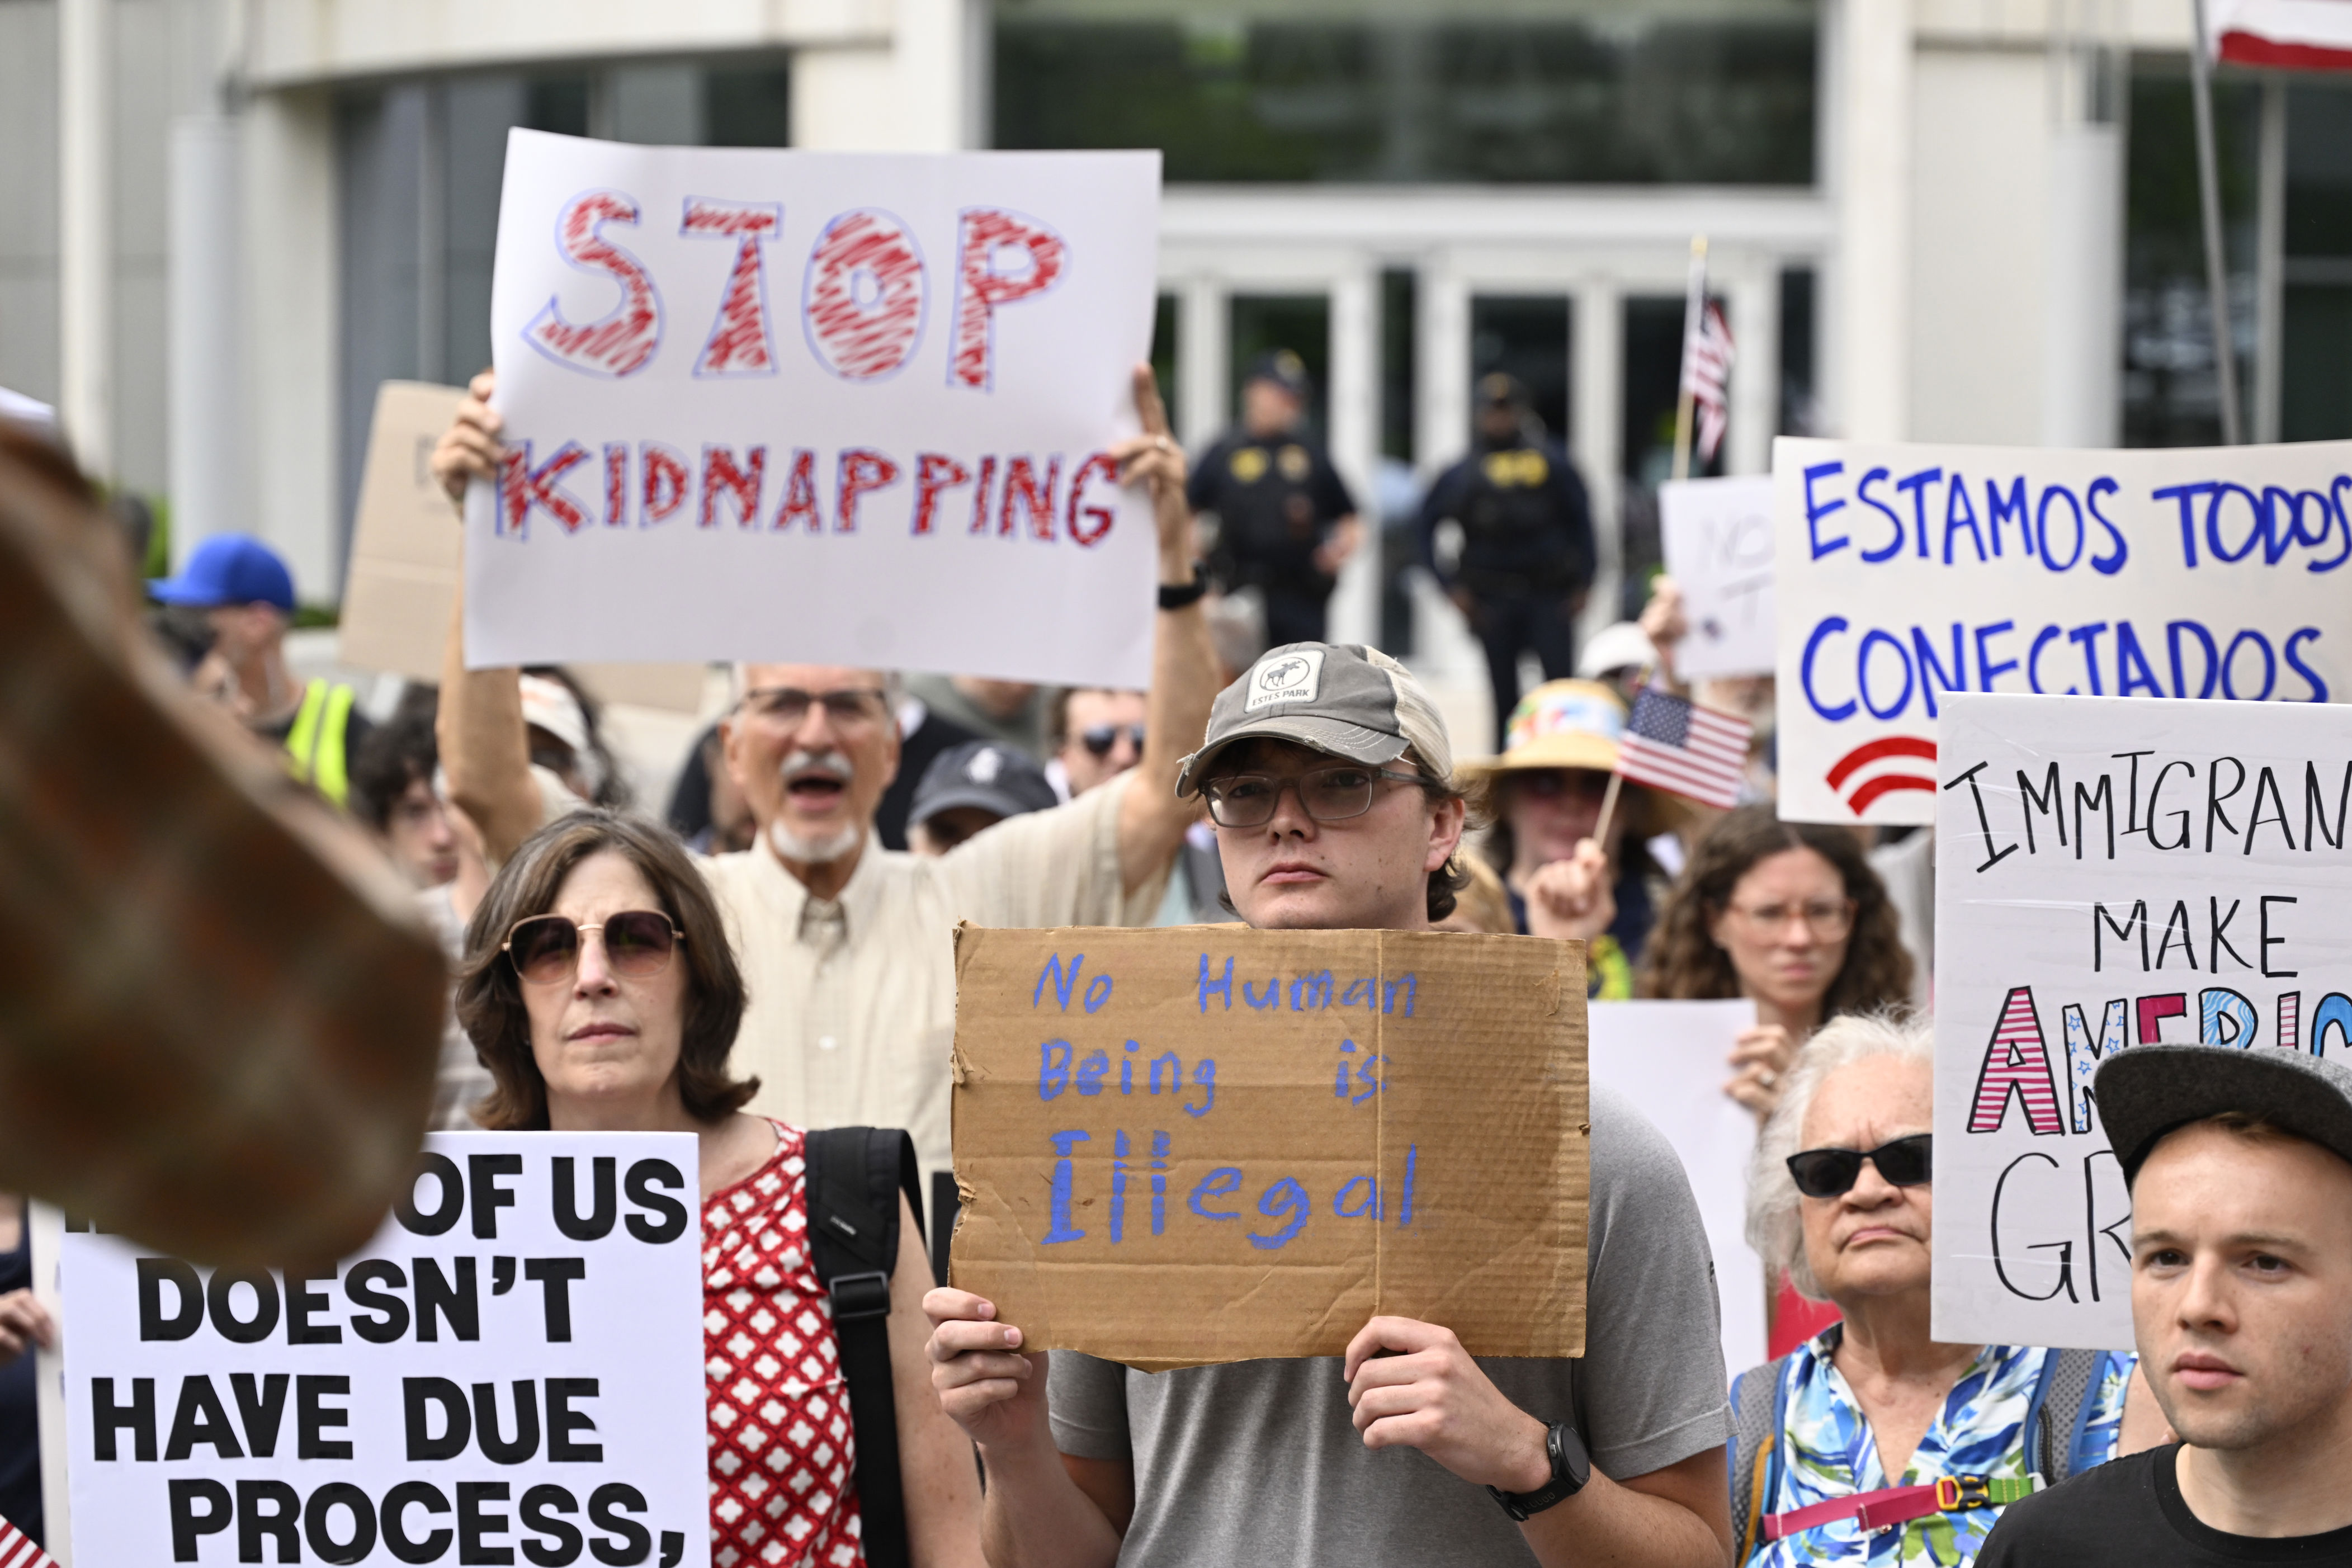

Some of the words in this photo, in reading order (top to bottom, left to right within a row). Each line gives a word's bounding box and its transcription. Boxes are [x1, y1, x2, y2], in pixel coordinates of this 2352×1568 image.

[520, 187, 1073, 394] STOP
[495, 438, 1120, 548] KIDNAPPING
[1804, 461, 2127, 575] ESTAMOS
[2152, 474, 2352, 574] TODOS
[1253, 692, 1279, 706] ESTES
[1283, 689, 1310, 697] PARK
[1944, 750, 2352, 873] IMMIGRAN
[2094, 896, 2298, 977] MAKE
[1033, 952, 1113, 1013] No
[1197, 953, 1418, 1017] Human
[1039, 1038, 1216, 1117] Being
[1335, 1039, 1390, 1107] is
[393, 1152, 523, 1239] OF
[551, 1156, 688, 1244] US
[1040, 1130, 1417, 1250] Illegal
[136, 1256, 585, 1345] DOESN'T
[91, 1373, 353, 1462] HAVE
[402, 1377, 603, 1465] DUE
[168, 1479, 685, 1568] PROCESS,
